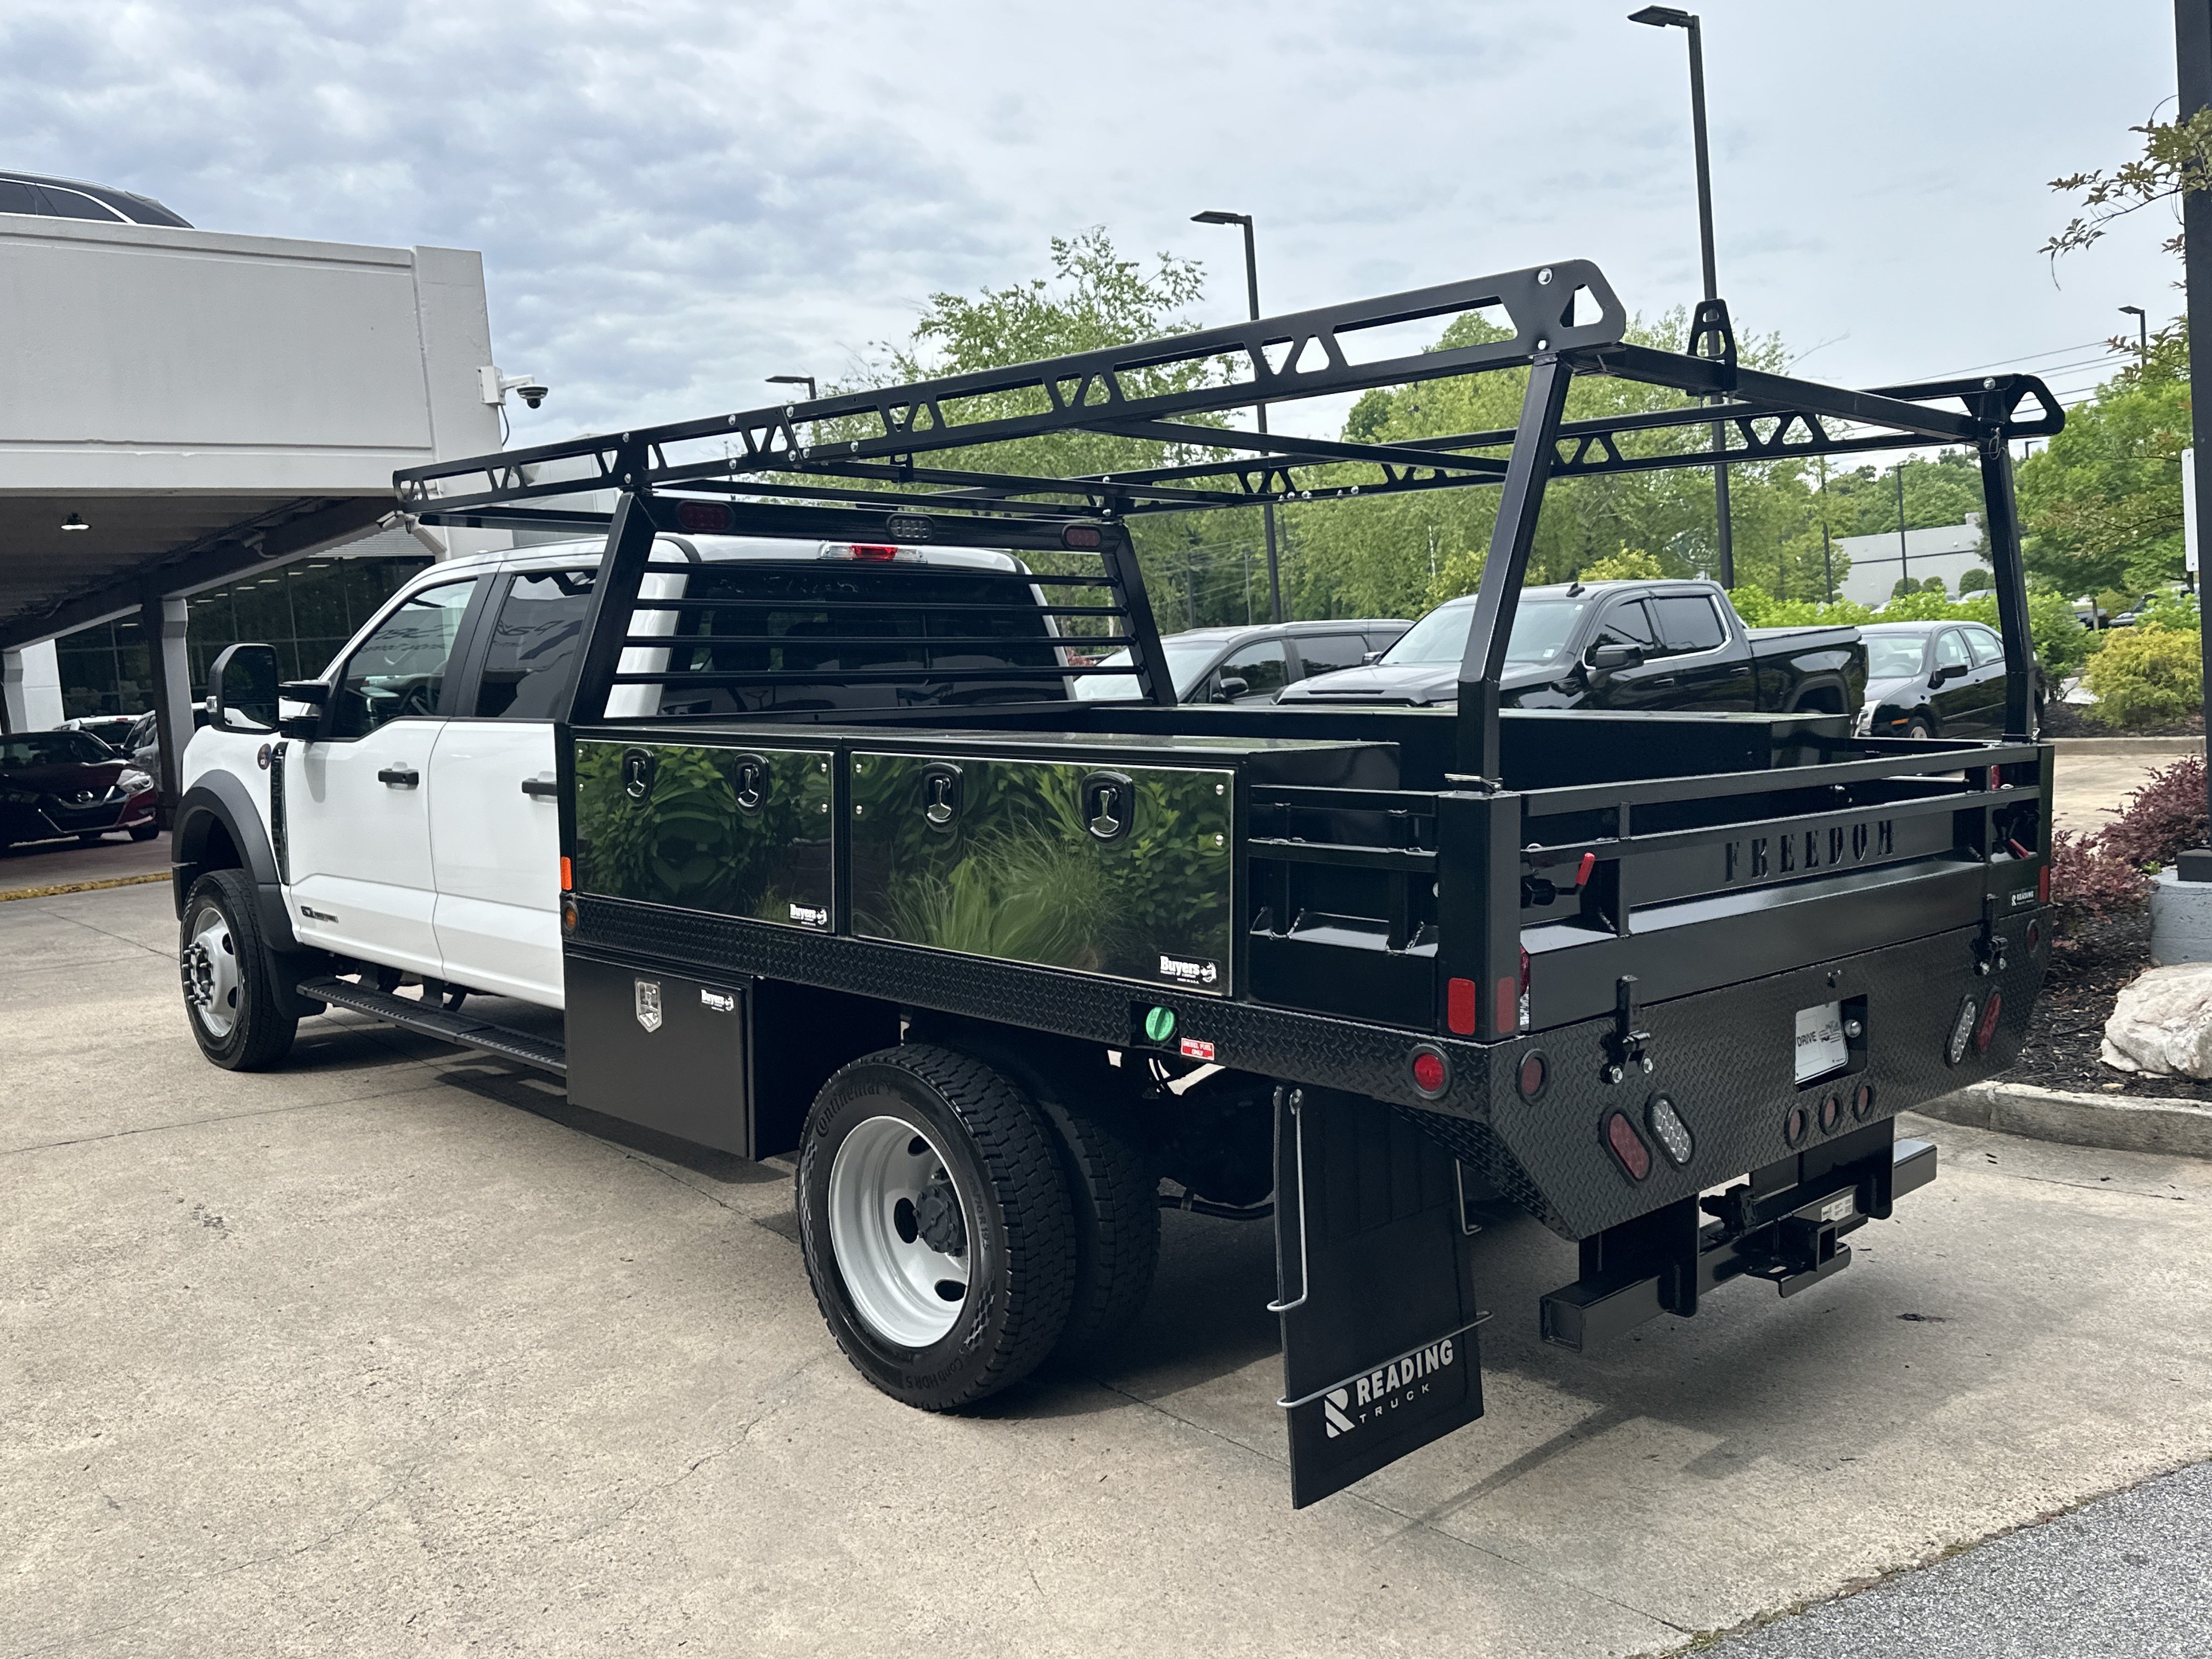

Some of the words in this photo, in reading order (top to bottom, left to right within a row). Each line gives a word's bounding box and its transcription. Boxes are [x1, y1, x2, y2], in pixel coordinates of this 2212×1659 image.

[1725, 819, 1893, 882] FREEDOM
[789, 903, 816, 919] Buyers
[1160, 955, 1200, 976] Buyers
[701, 989, 725, 1005] Buyers
[1356, 1339, 1454, 1407] READING
[1359, 1383, 1430, 1424] TRUCK
